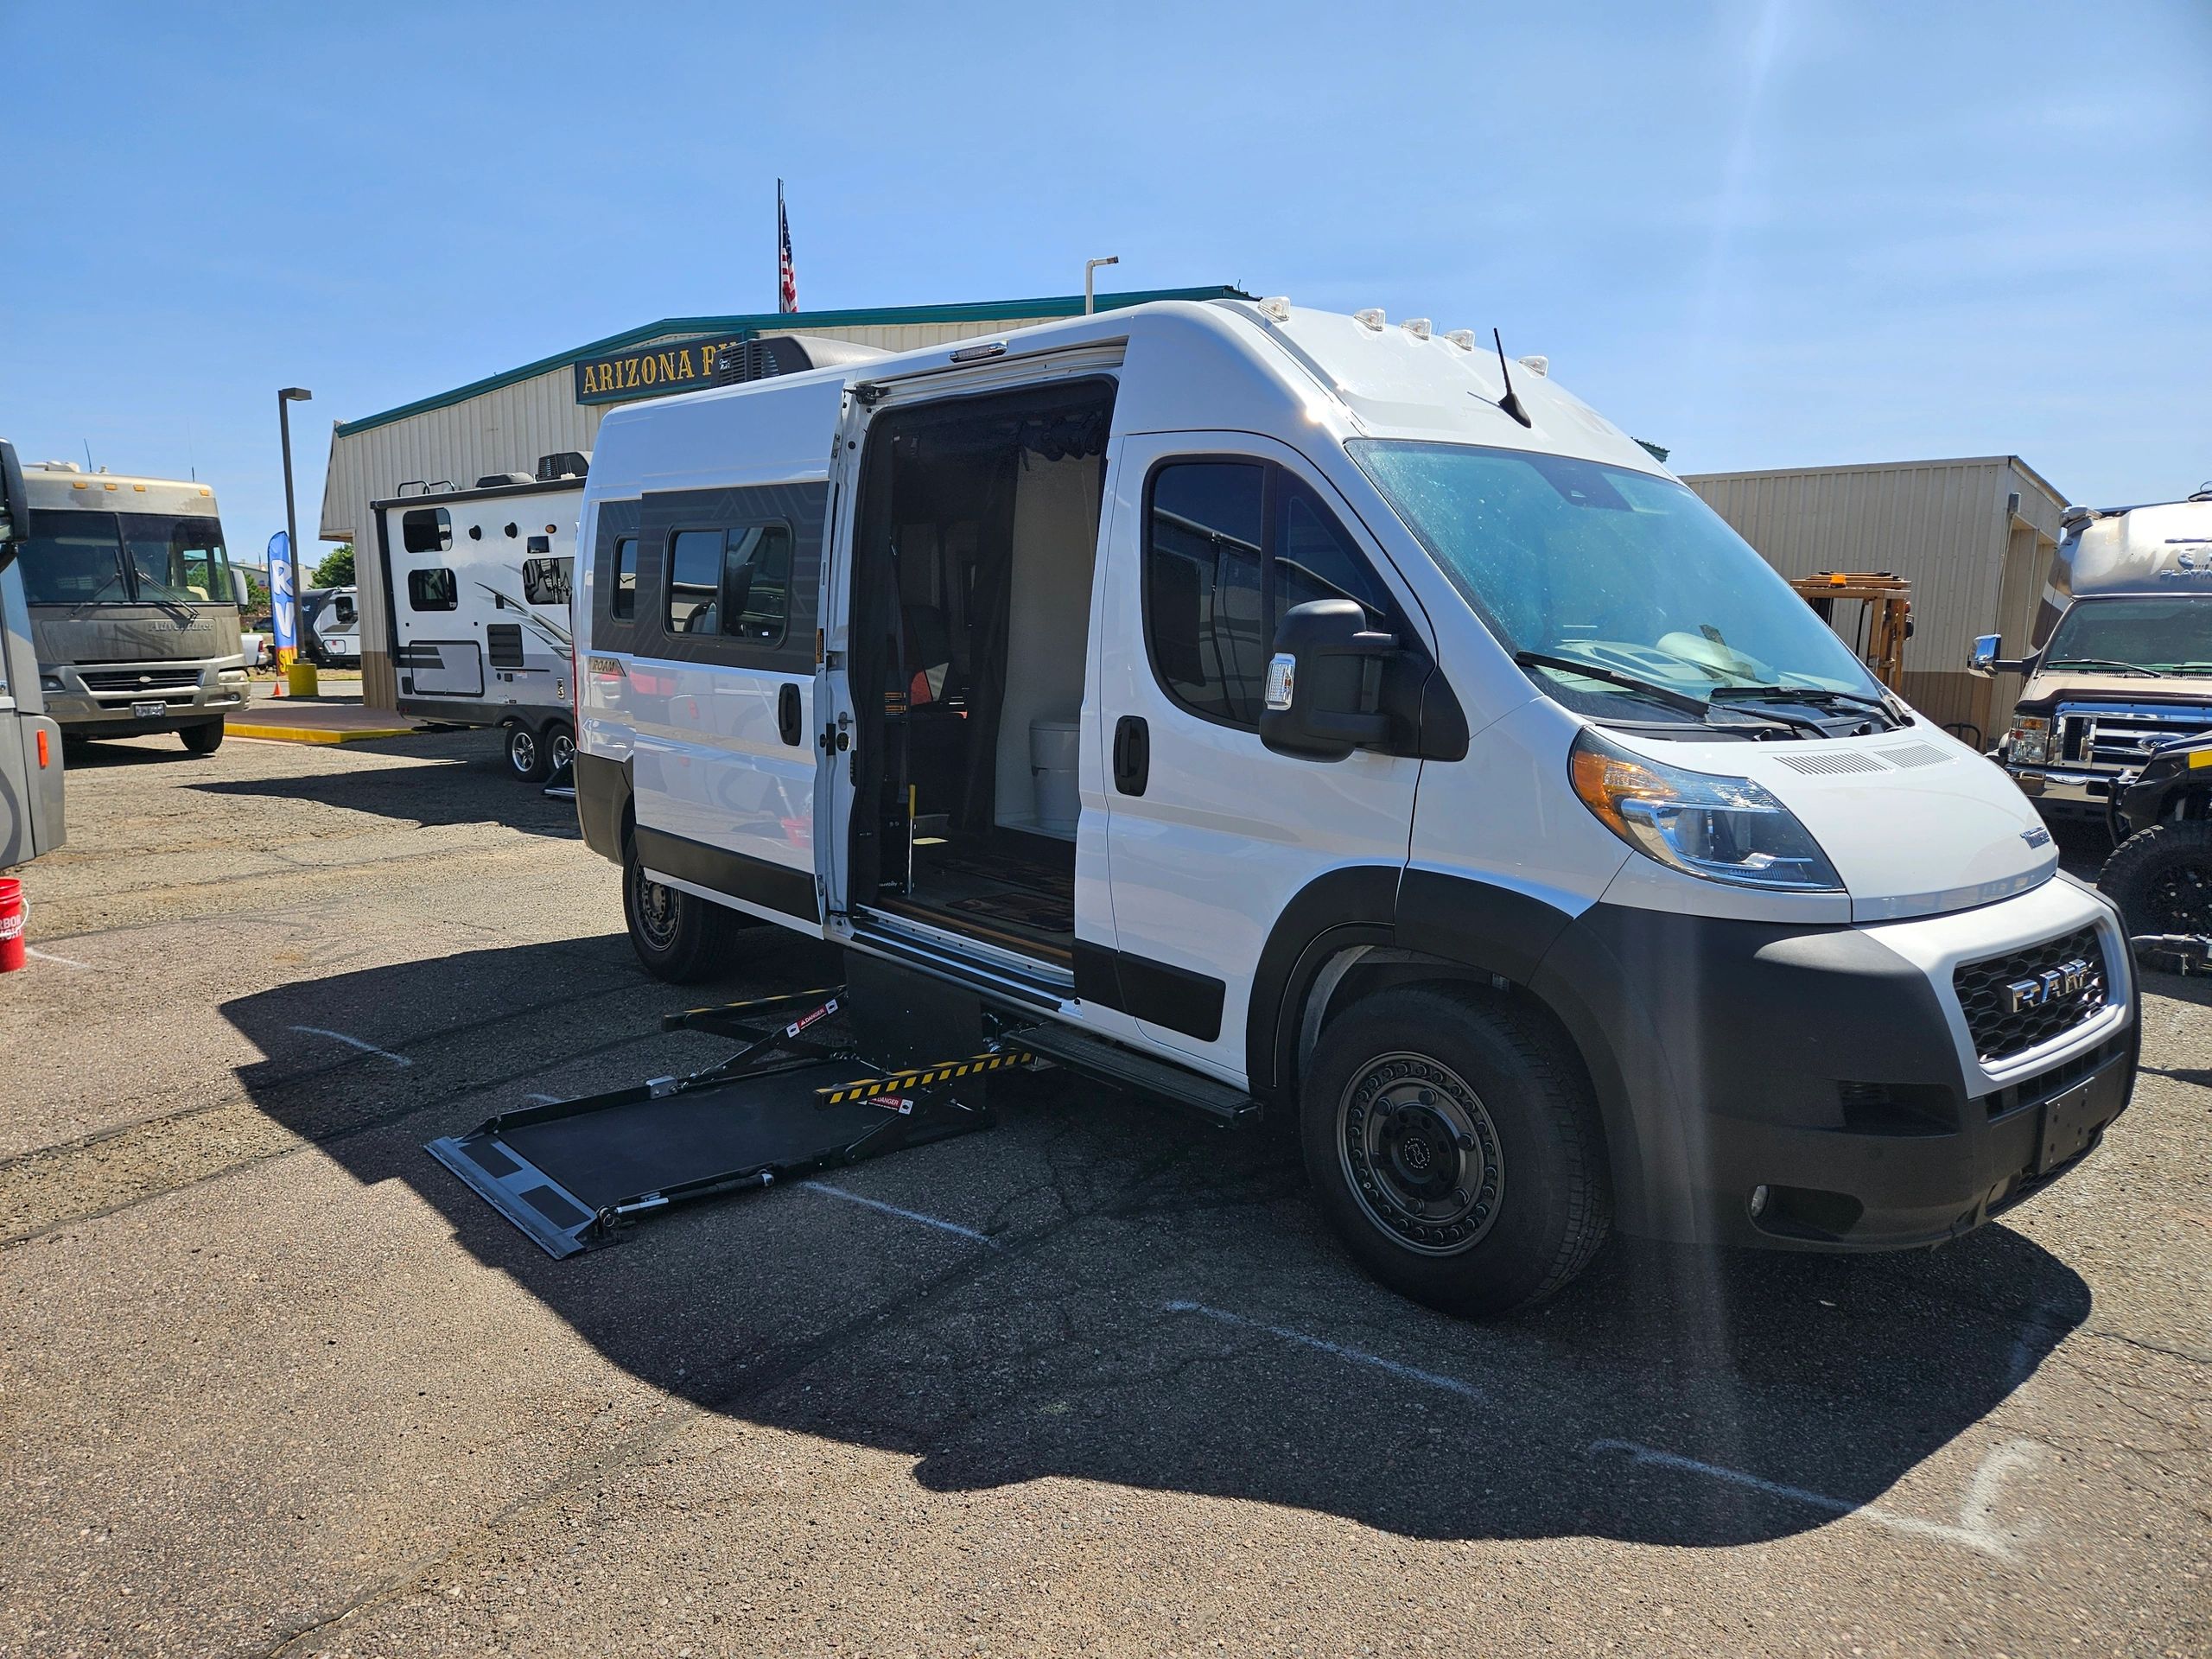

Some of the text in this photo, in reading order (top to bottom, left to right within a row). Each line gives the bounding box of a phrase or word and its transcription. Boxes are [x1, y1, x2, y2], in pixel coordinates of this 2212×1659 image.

[582, 349, 695, 394] ARIZONA
[592, 659, 615, 672] ROAM
[2005, 958, 2088, 1014] RAM
[804, 1007, 825, 1023] DANGER
[877, 1096, 899, 1106] DANGER
